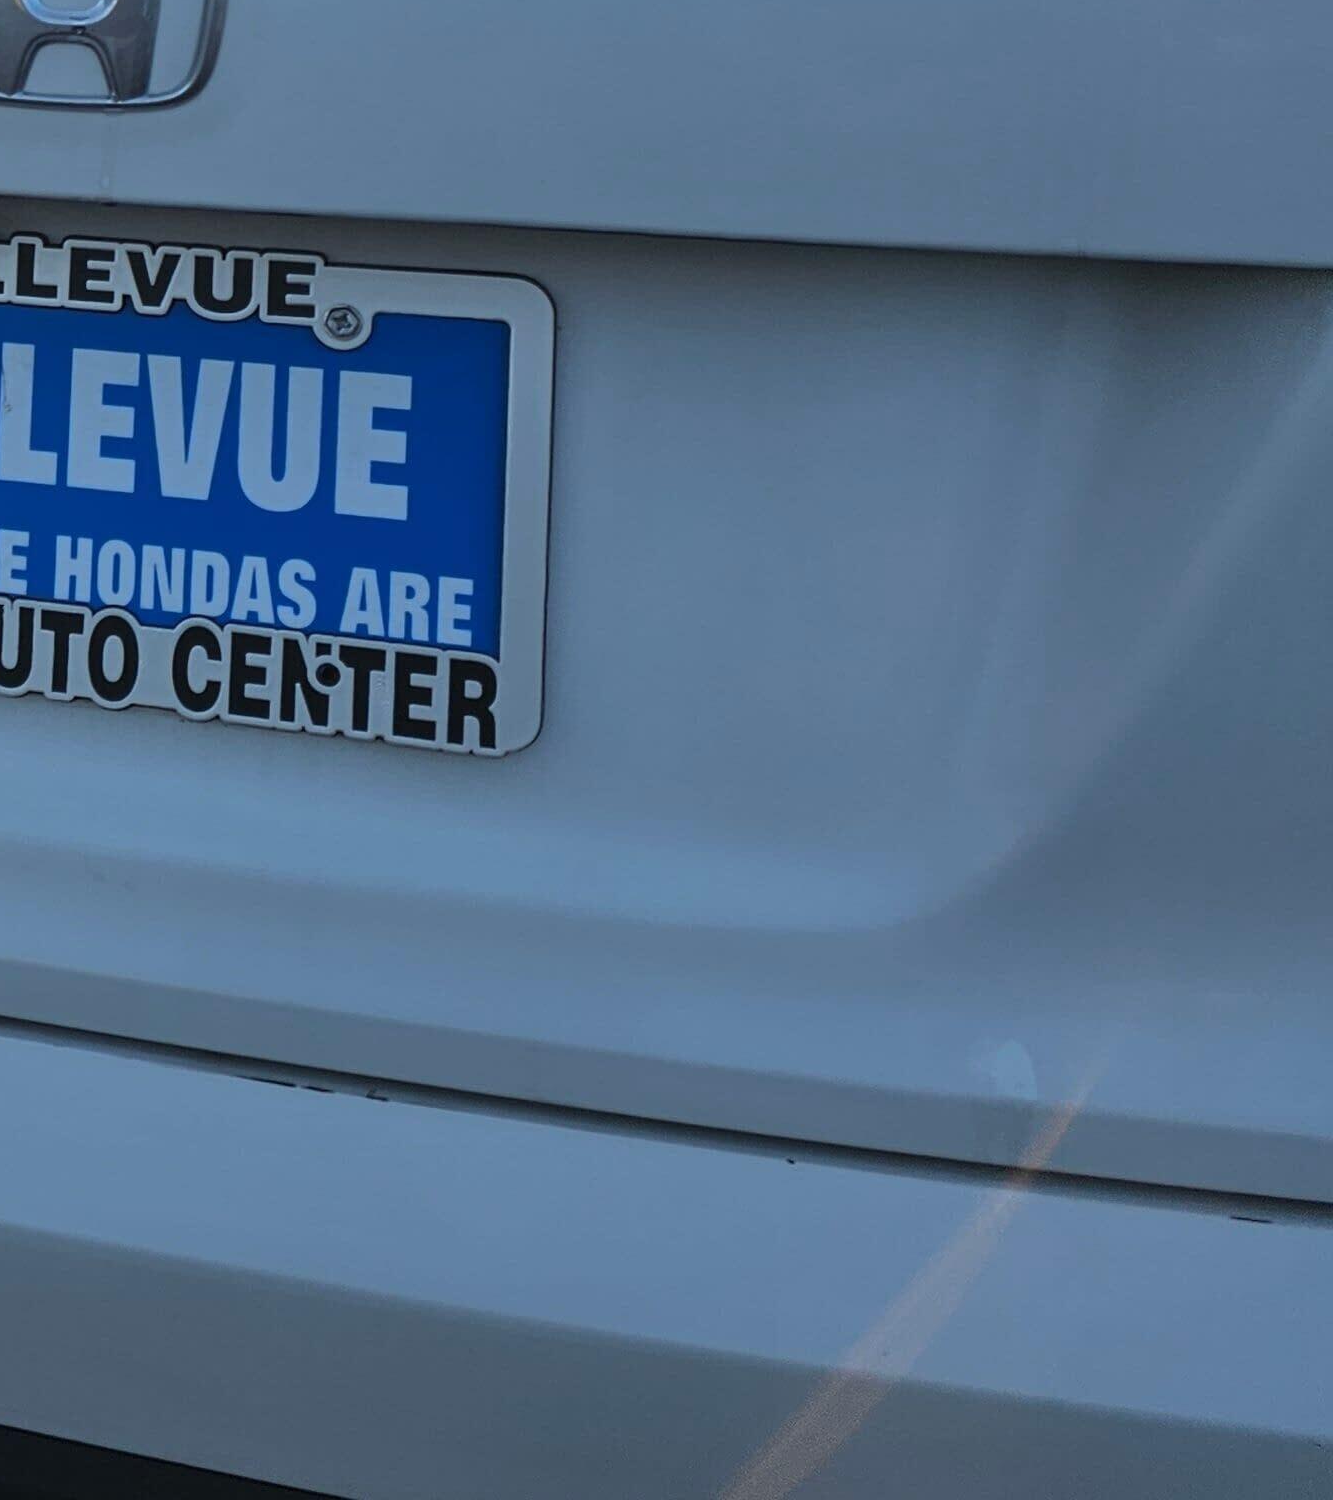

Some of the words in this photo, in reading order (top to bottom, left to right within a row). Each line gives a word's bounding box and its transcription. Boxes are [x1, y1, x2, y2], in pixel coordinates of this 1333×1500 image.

[53, 535, 317, 629] HONDAS
[339, 567, 475, 647] ARE
[172, 626, 498, 750] CENTER
